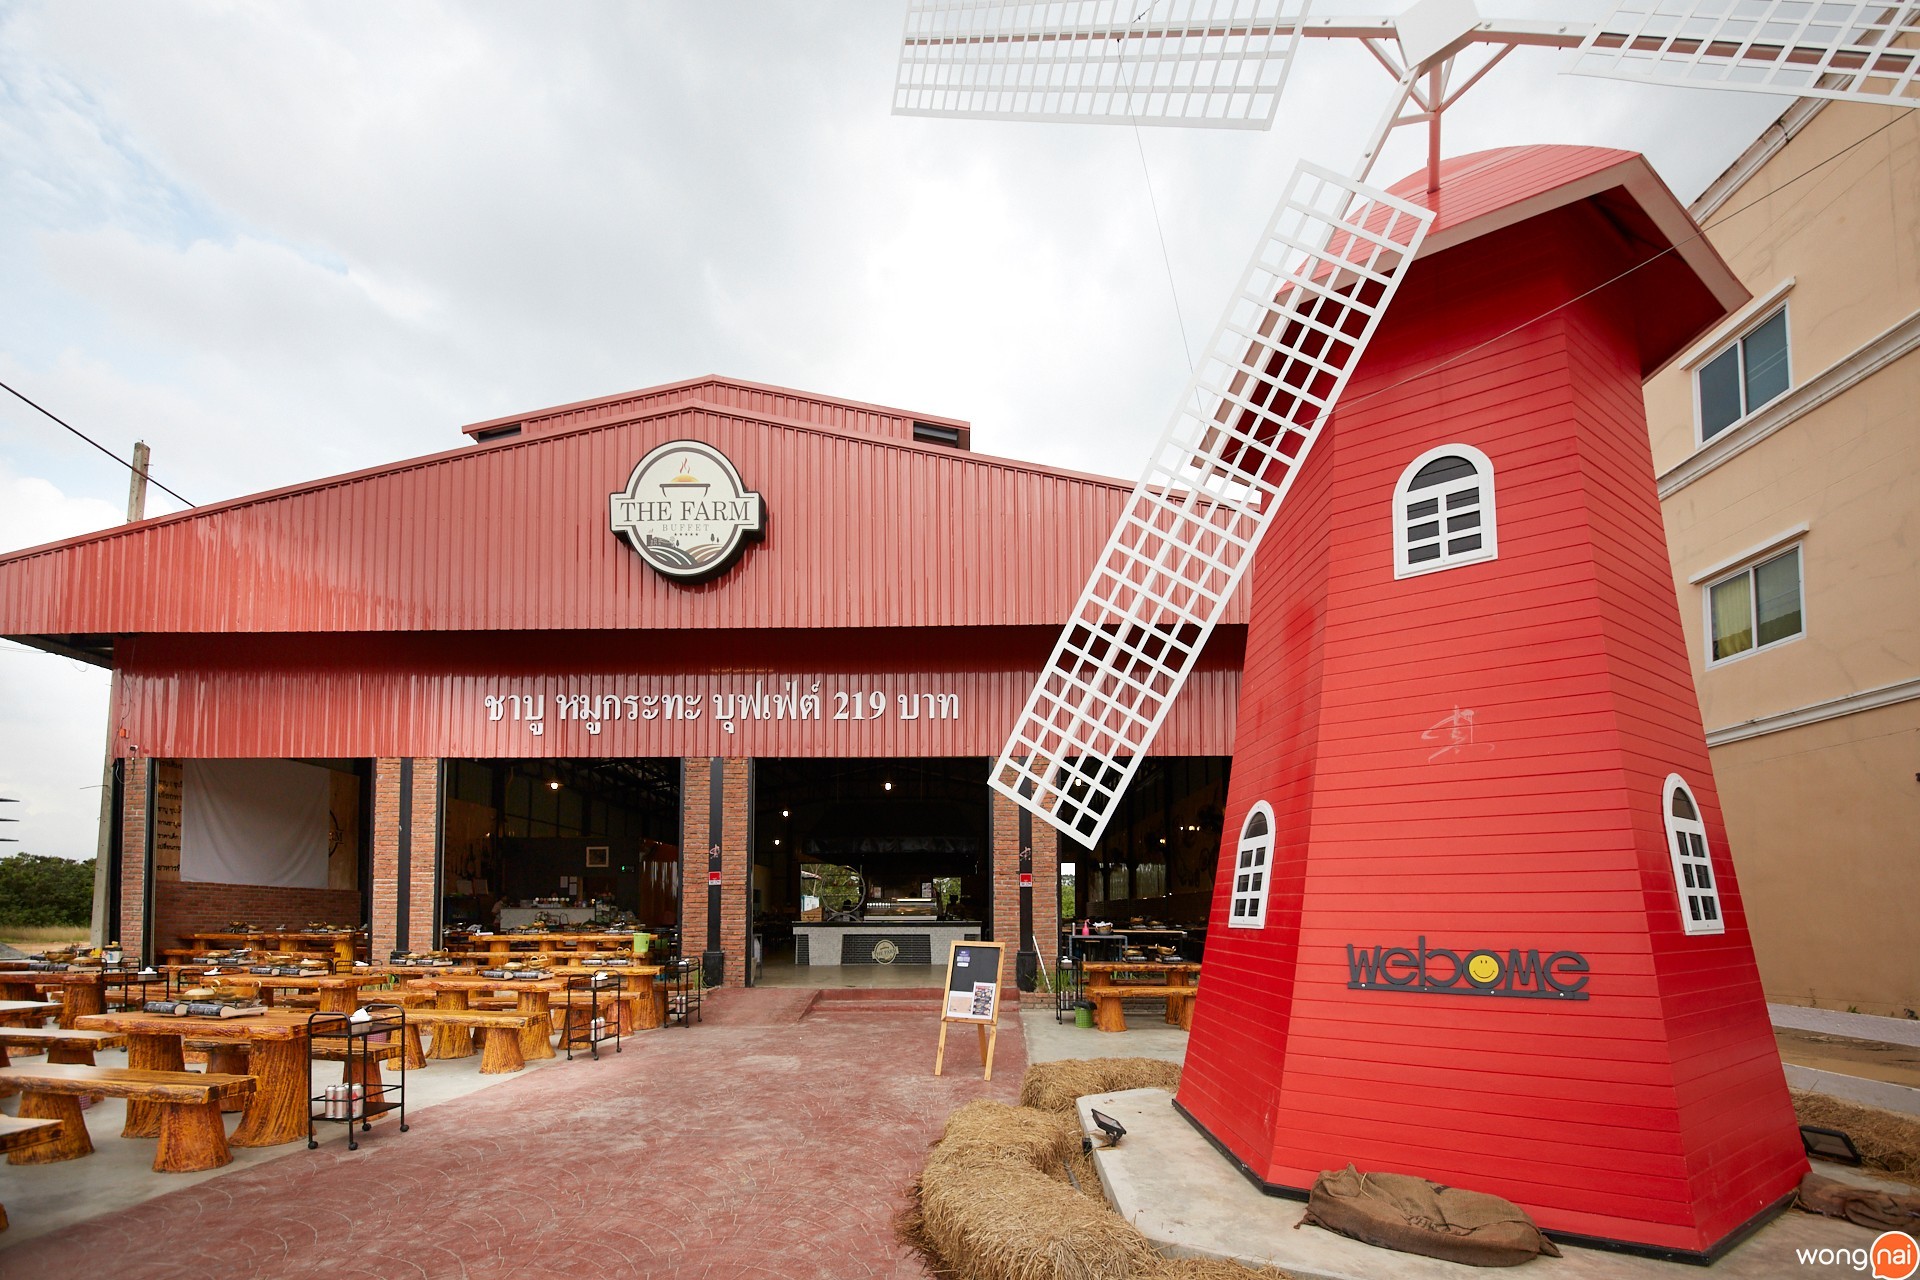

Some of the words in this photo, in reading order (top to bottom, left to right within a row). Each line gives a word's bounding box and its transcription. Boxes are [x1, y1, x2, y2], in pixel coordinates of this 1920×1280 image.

[620, 501, 672, 522] THE
[680, 500, 751, 521] FARM
[662, 523, 710, 532] BUFFET
[484, 694, 544, 735] ชาบู
[556, 693, 702, 735] หมูกระทะ
[712, 680, 821, 734] บุฟเฟ่ต์
[833, 690, 887, 720] 219
[897, 693, 959, 720] บาท
